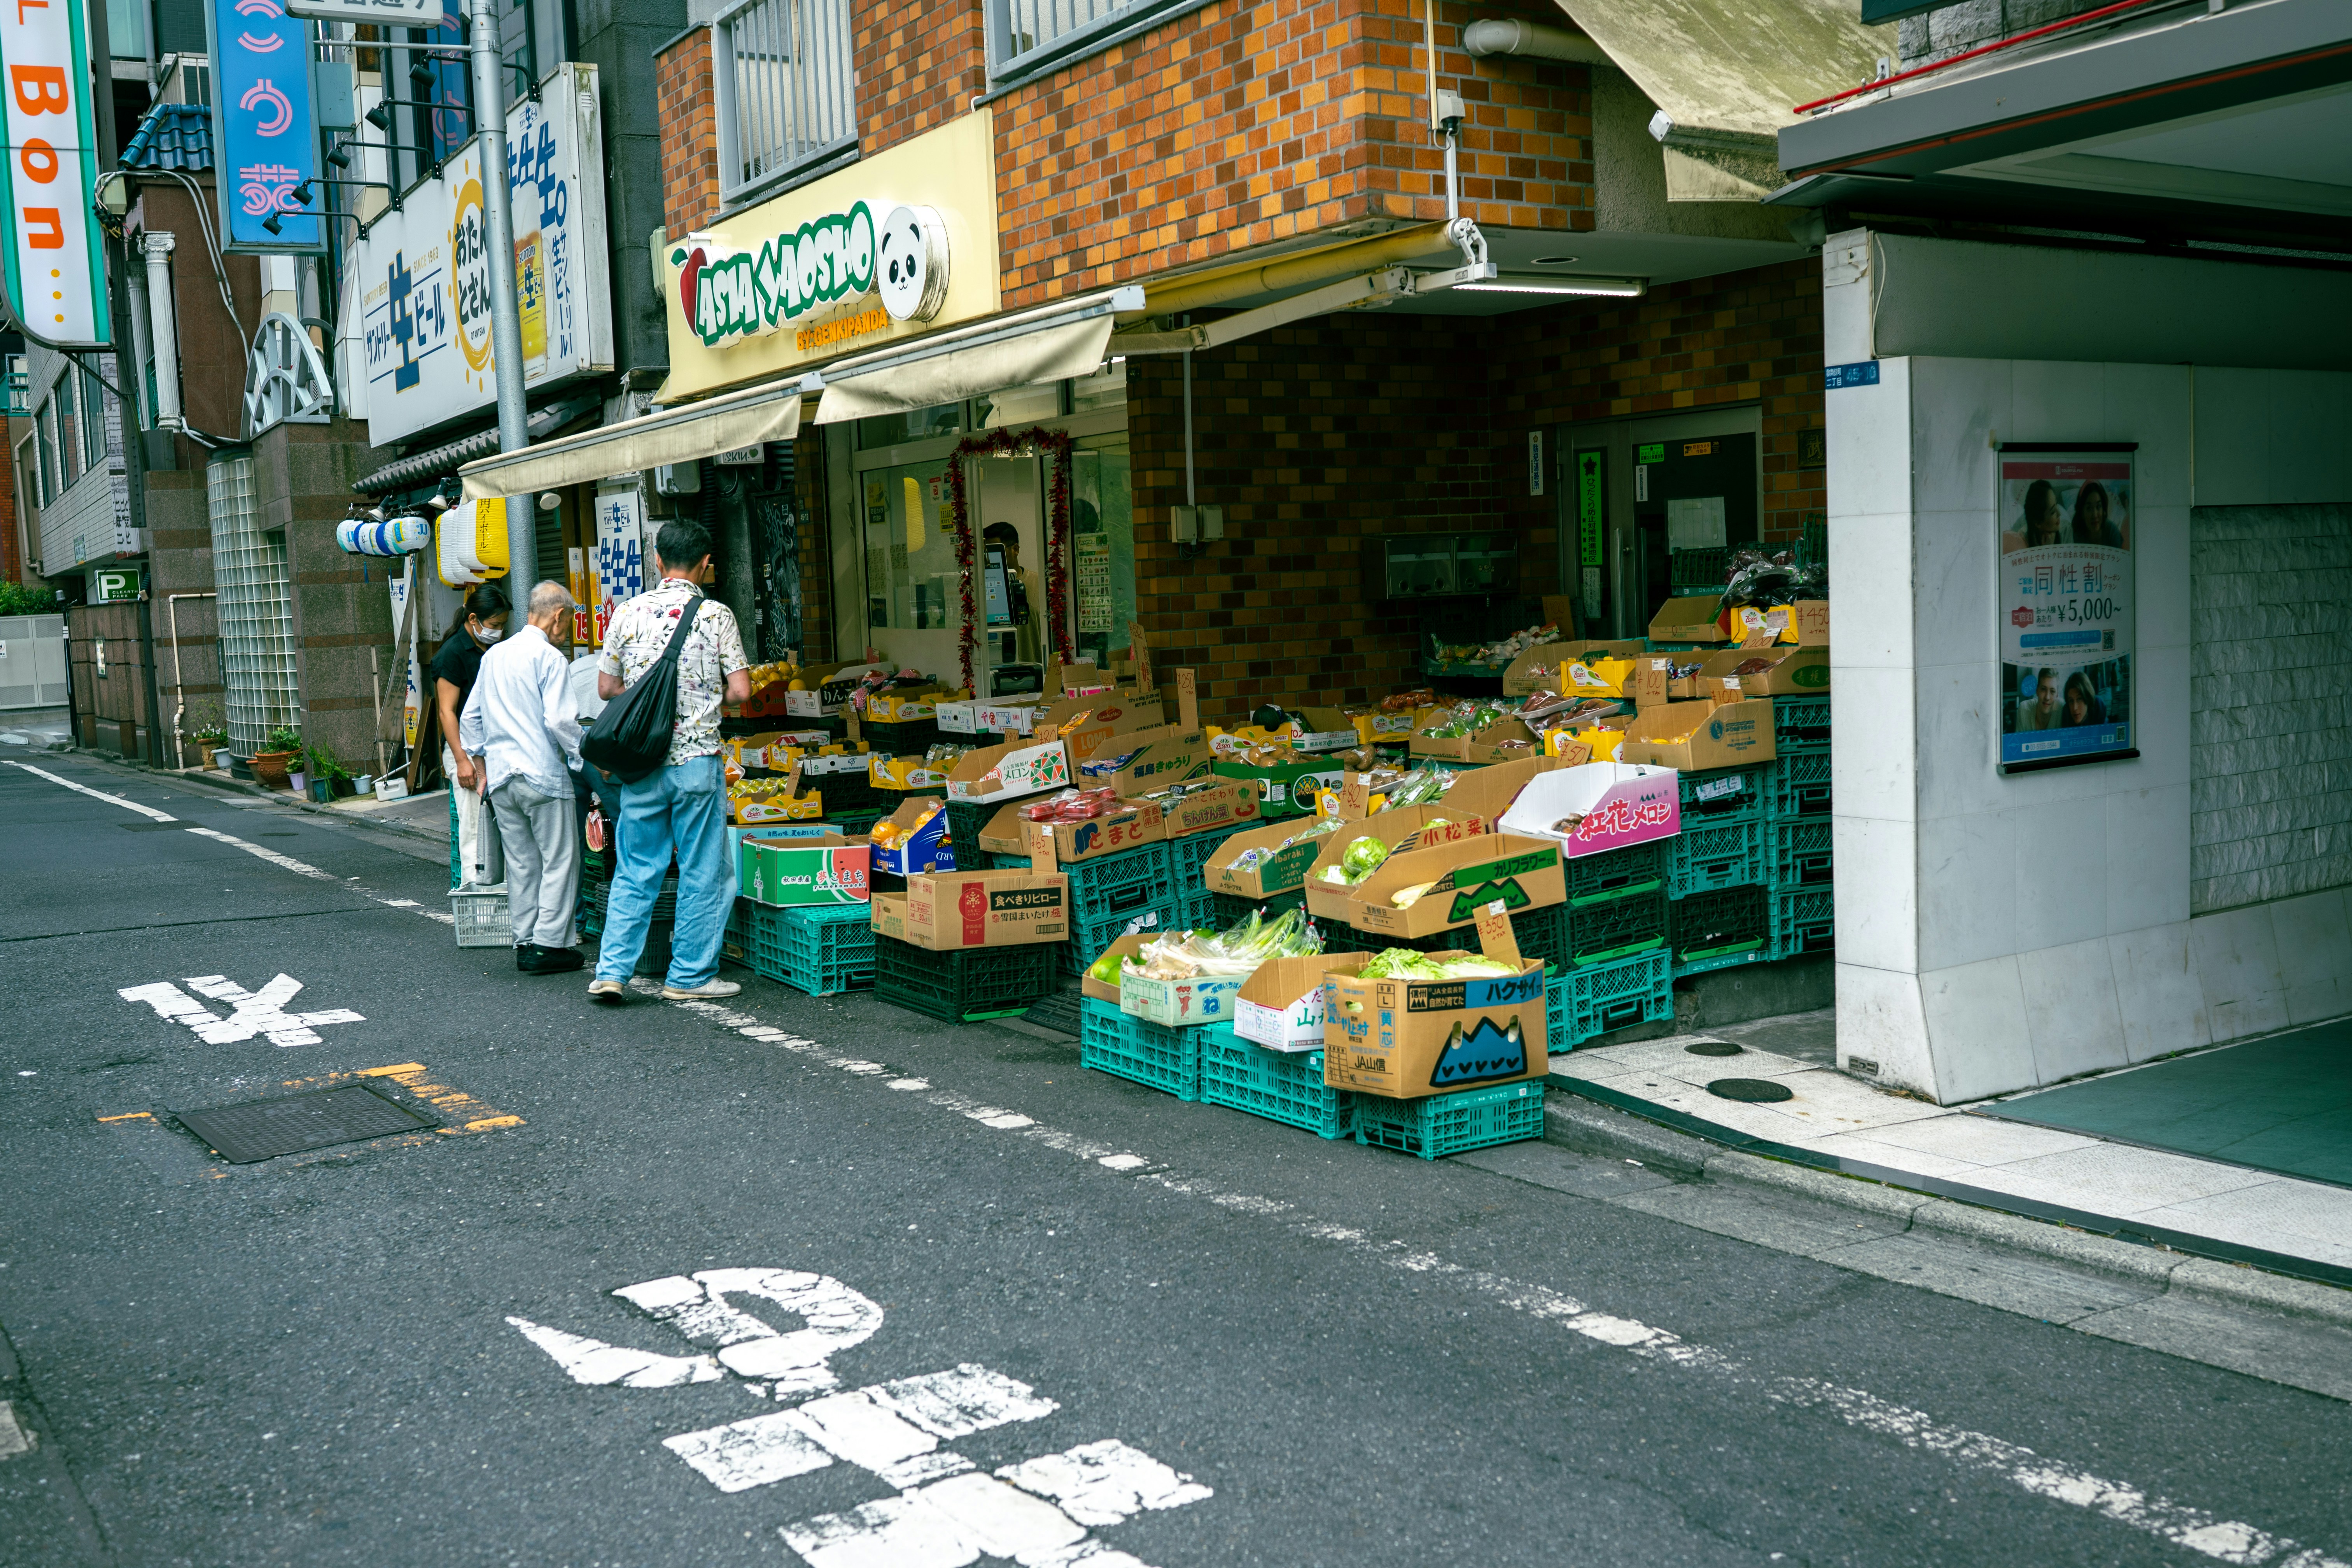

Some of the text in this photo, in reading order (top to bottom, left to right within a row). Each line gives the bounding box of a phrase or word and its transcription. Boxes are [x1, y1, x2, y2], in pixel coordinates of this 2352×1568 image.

[413, 246, 438, 273] SINCE 1963
[519, 244, 536, 264] SUNTORY
[698, 212, 870, 337] ASIA YAOSHO
[364, 281, 387, 306] SUNTORY BEER
[552, 235, 568, 359] 生ビール
[560, 229, 572, 354] サントリー
[471, 326, 485, 340] OTANTSAN
[1826, 377, 1842, 386] 二丁目
[1846, 366, 1876, 382] 45-10
[1587, 478, 1597, 562] ひったくり防止対策推進地区
[100, 574, 126, 599] P
[2035, 562, 2103, 596] 同性割
[2013, 612, 2033, 622] ご宿泊
[2036, 606, 2056, 614] お一人様
[2036, 614, 2052, 623] あたり
[1178, 672, 1195, 690] ¥250
[1636, 670, 1662, 689] ¥100
[1559, 742, 1587, 765] ¥50
[1004, 767, 1031, 781] メロン
[1134, 754, 1191, 778] 福島きゅうり
[1200, 788, 1235, 804] こだわり
[1183, 805, 1229, 827] ちんげん菜
[1576, 797, 1671, 842] 紅花メロン
[1089, 822, 1143, 850] とまと
[1423, 818, 1482, 846] 小松菜
[1031, 833, 1048, 850] ¥65
[1274, 847, 1305, 864] Ibaraki
[1281, 862, 1300, 872] いいもの
[817, 870, 863, 883] 夢こまち
[995, 892, 1059, 907] 食べきりピロー
[1000, 910, 1050, 922] 雪国まいたけ
[1478, 914, 1504, 941] ¥350
[1382, 997, 1389, 1005] L
[1410, 988, 1428, 998] 信州
[1203, 996, 1220, 1015] ね
[1429, 998, 1465, 1008] 自然が育てた
[1380, 1012, 1393, 1045] 黄芯
[1354, 1055, 1386, 1071] JA山信
